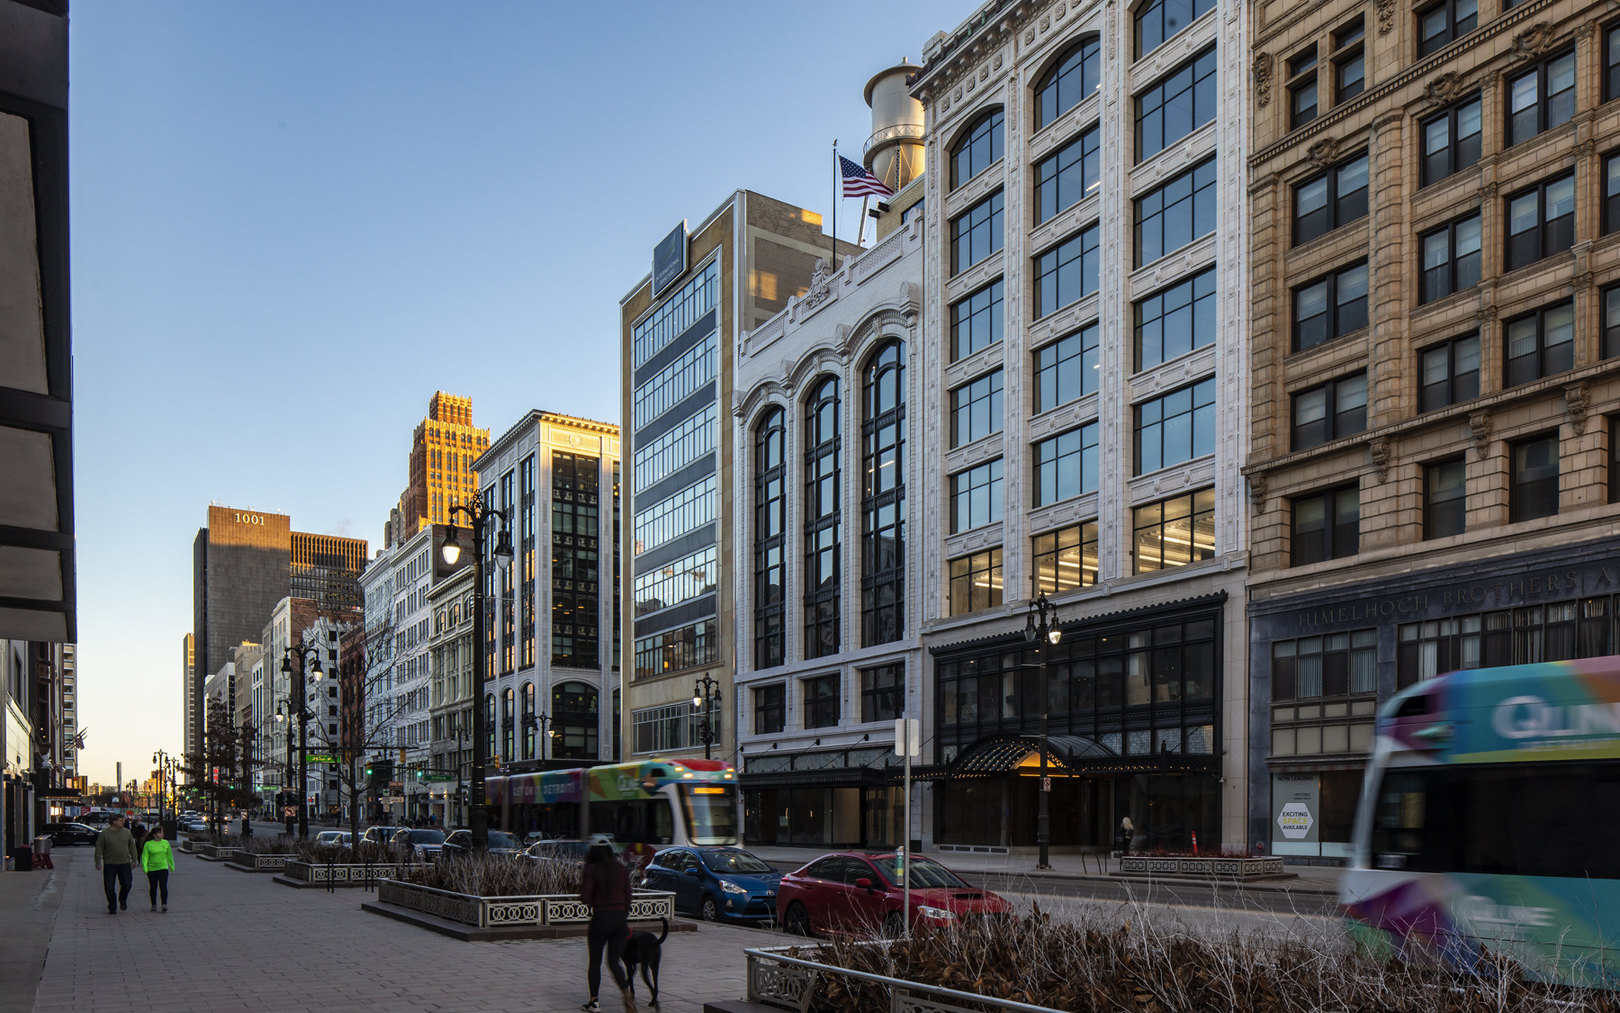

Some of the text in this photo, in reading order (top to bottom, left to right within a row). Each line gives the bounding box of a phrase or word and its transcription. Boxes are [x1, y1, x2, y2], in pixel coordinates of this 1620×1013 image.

[234, 512, 265, 526] 1001
[1298, 594, 1430, 627] HIMELHOCH
[1443, 571, 1577, 605] BROTHERS
